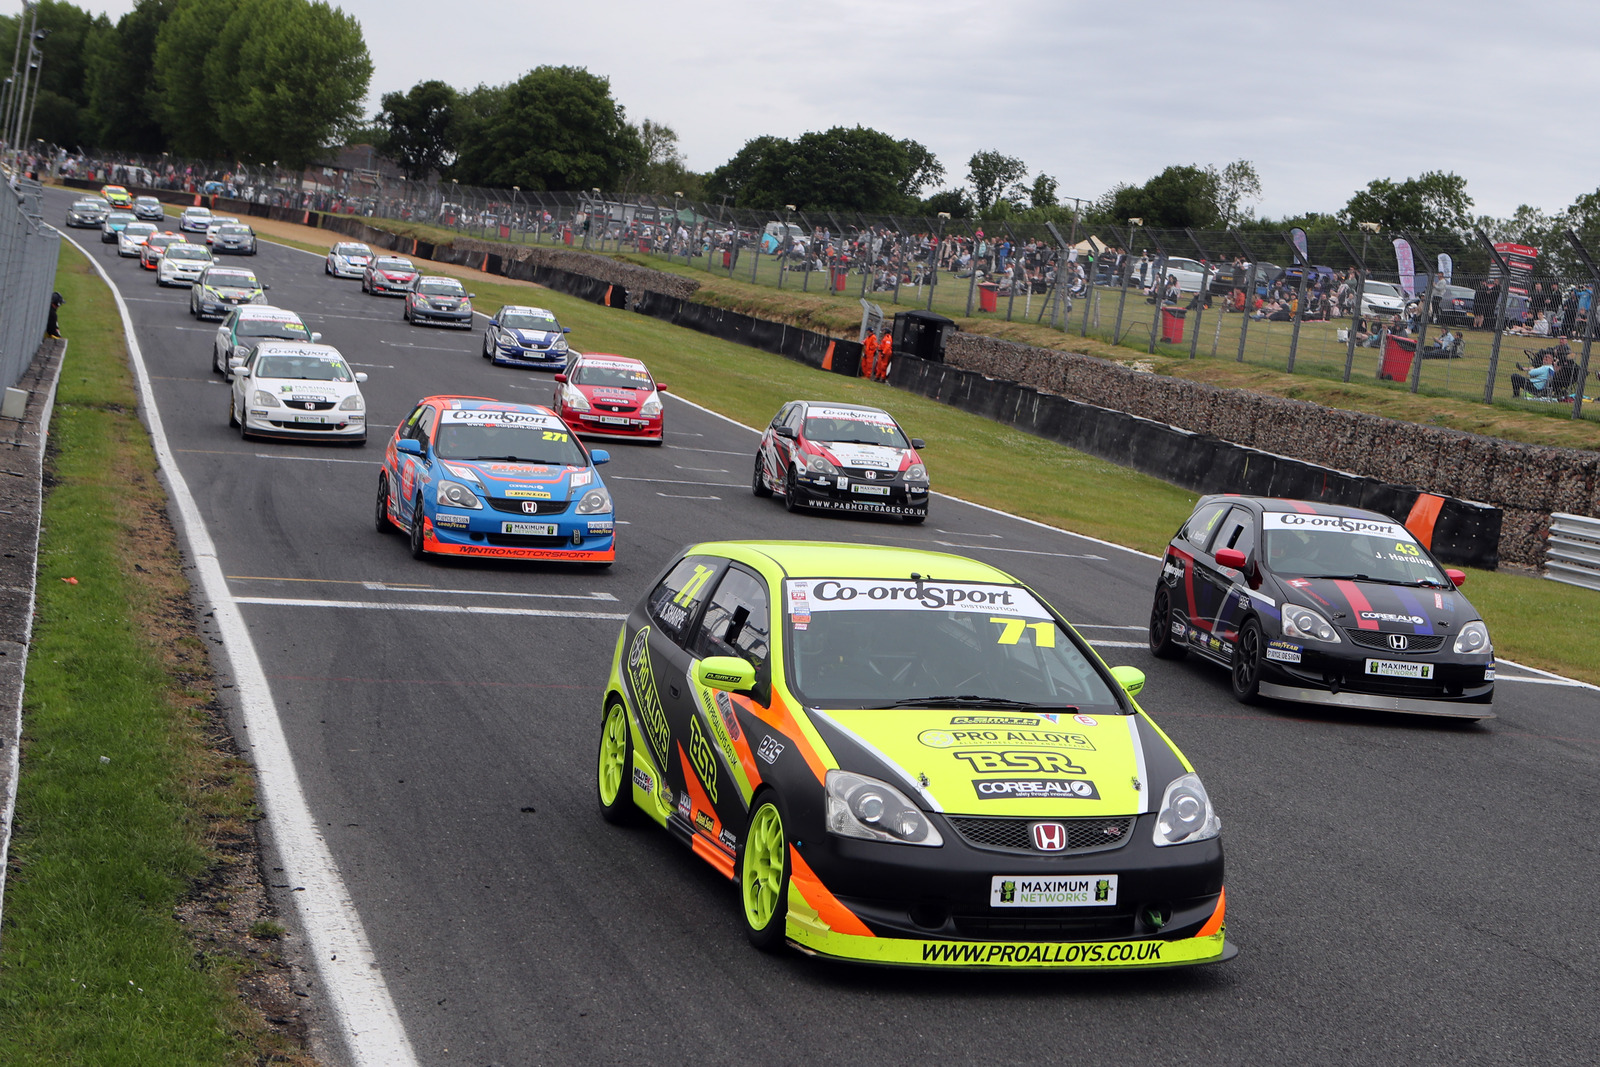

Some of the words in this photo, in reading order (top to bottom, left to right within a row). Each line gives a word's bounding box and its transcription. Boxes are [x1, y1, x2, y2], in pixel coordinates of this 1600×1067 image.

[453, 410, 548, 424] Co-ordSport
[542, 431, 568, 443] 271
[879, 426, 895, 435] 14
[808, 499, 926, 516] WWW.PABMORTGAGES.CO.UK
[1280, 514, 1395, 534] Co-ordSport
[1395, 543, 1419, 556] 43
[1388, 553, 1434, 568] Harding
[673, 564, 714, 608] 71
[812, 579, 1014, 609] Co-ordSport
[960, 603, 1019, 613] DISTRIBUTION
[1361, 611, 1412, 623] CORBEAU
[989, 617, 1056, 648] 71
[1282, 652, 1301, 662] DESIGN
[1380, 669, 1418, 677] NETWORKS
[1381, 662, 1419, 672] MAXIMUM
[637, 647, 650, 691] PRO
[645, 682, 669, 753] ALLOYS
[952, 731, 999, 741] PRO
[1007, 731, 1086, 745] ALLOYS
[690, 714, 718, 804] BSR
[953, 750, 1087, 774] BSR
[978, 781, 1071, 794] CORBEAU
[1021, 880, 1089, 893] MAXIMUM
[1020, 892, 1088, 903] NETWORKS
[922, 942, 1164, 963] WWW.PROALLOYS.CO.UK
